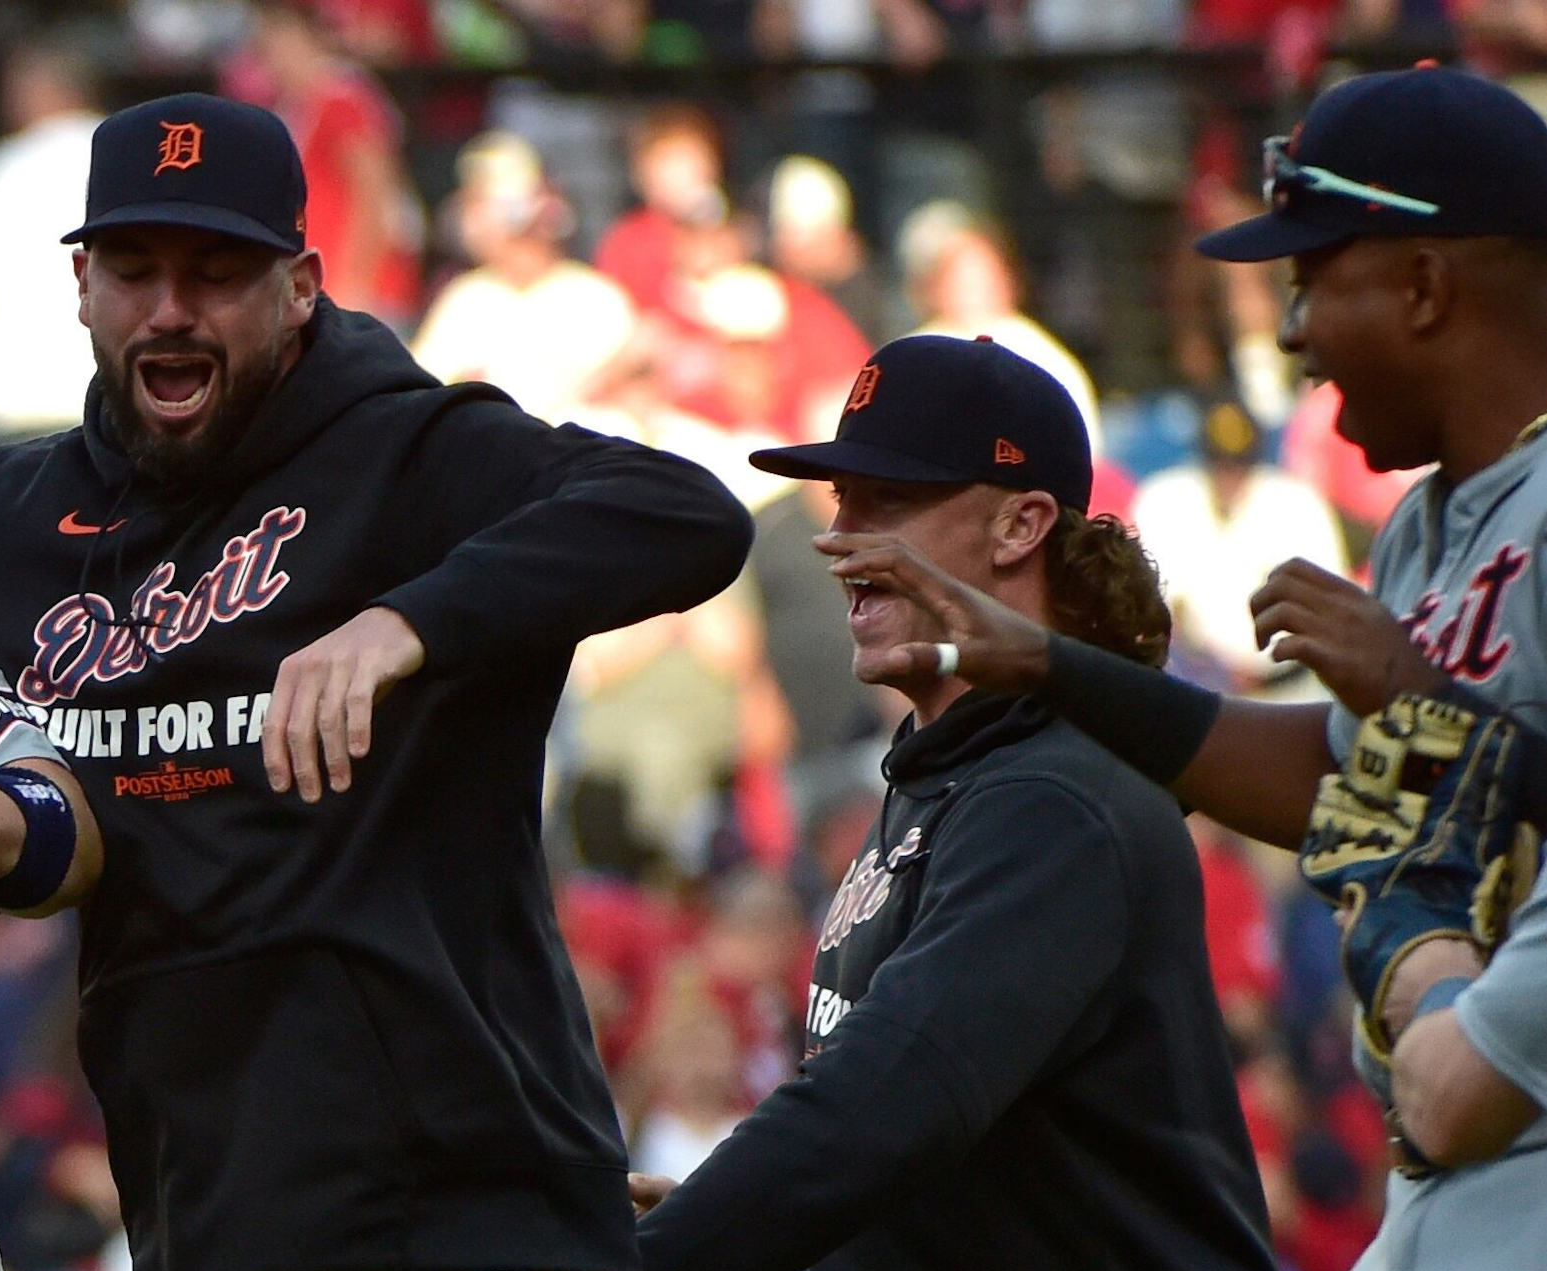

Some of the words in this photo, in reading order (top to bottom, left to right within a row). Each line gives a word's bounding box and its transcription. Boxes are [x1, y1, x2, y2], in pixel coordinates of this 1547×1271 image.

[16, 506, 307, 706] Detroit
[137, 701, 214, 756] FOR
[226, 693, 276, 746] FA
[114, 767, 234, 796] POSTSEASON
